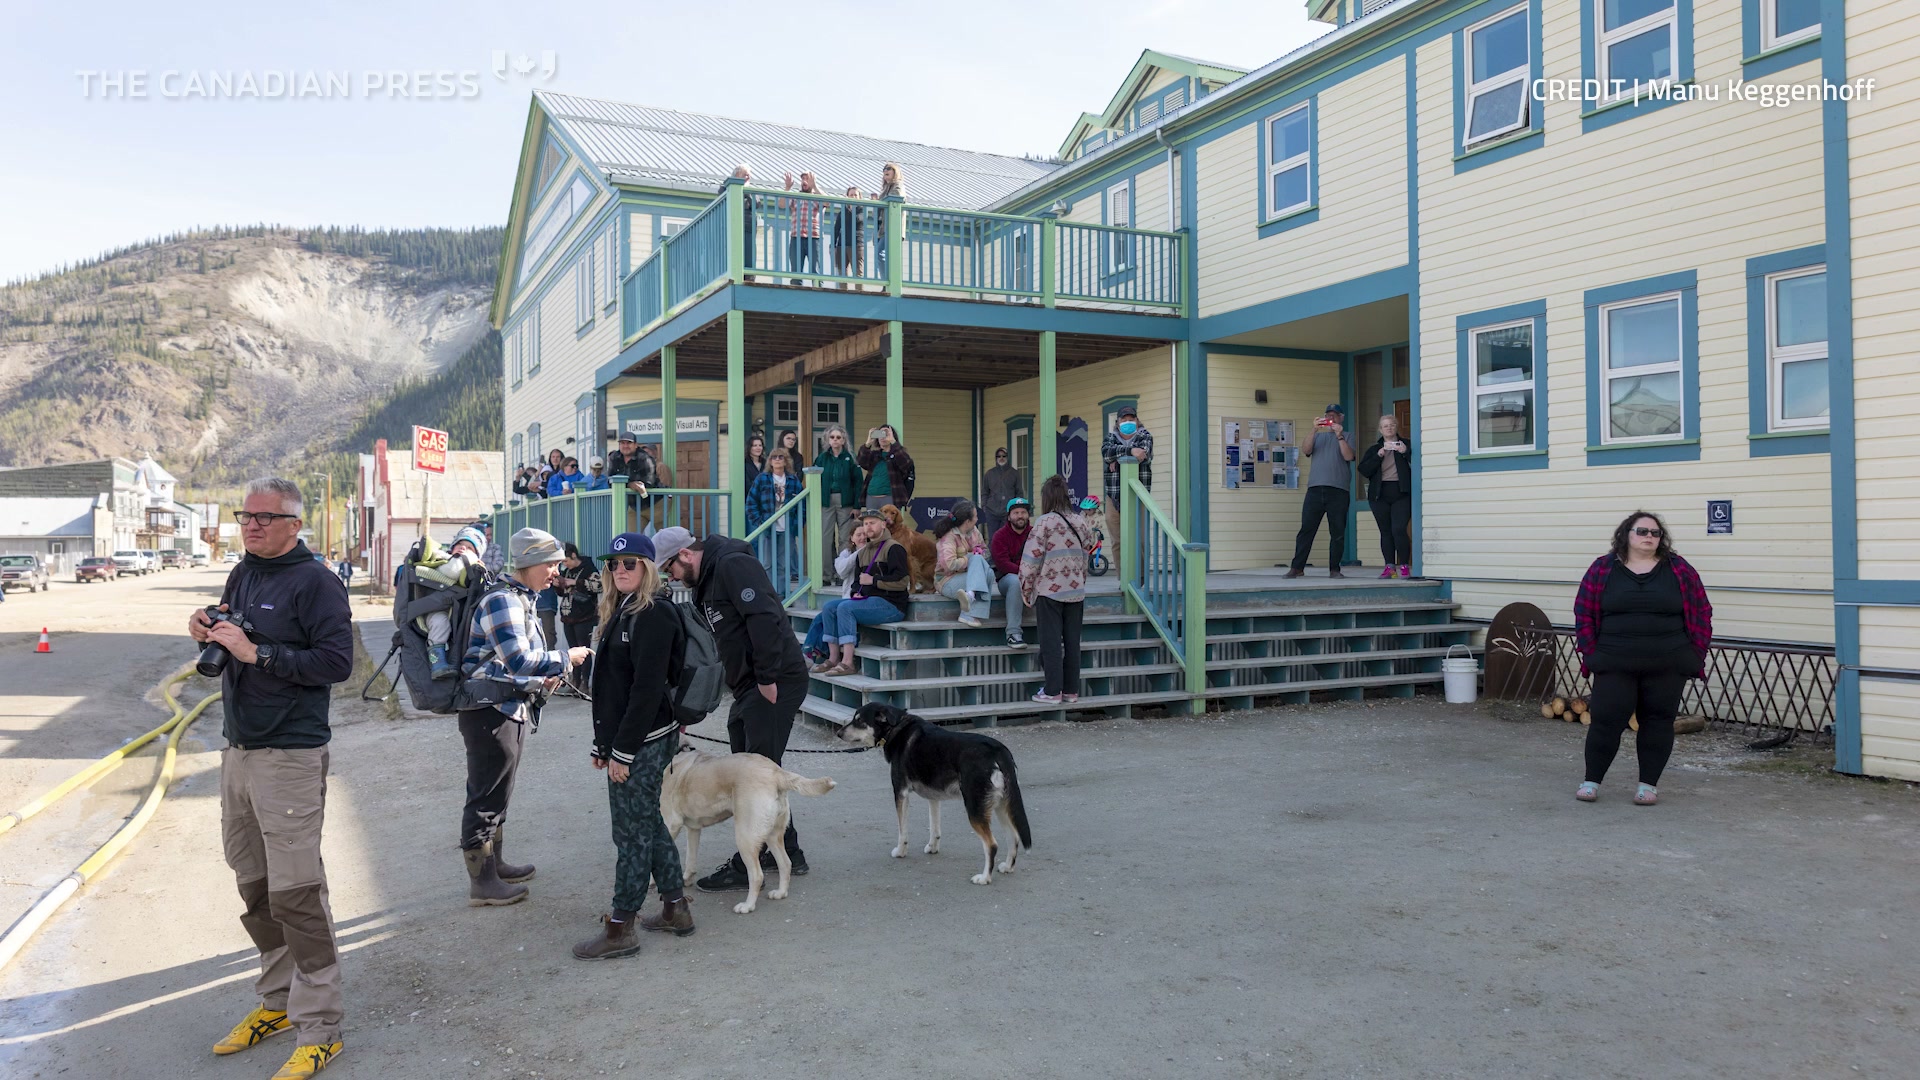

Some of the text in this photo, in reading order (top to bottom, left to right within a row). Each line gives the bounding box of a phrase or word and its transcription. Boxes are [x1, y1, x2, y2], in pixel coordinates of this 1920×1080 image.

[628, 420, 708, 432] Yukon Scho Visual Arts
[419, 430, 446, 452] GAS
